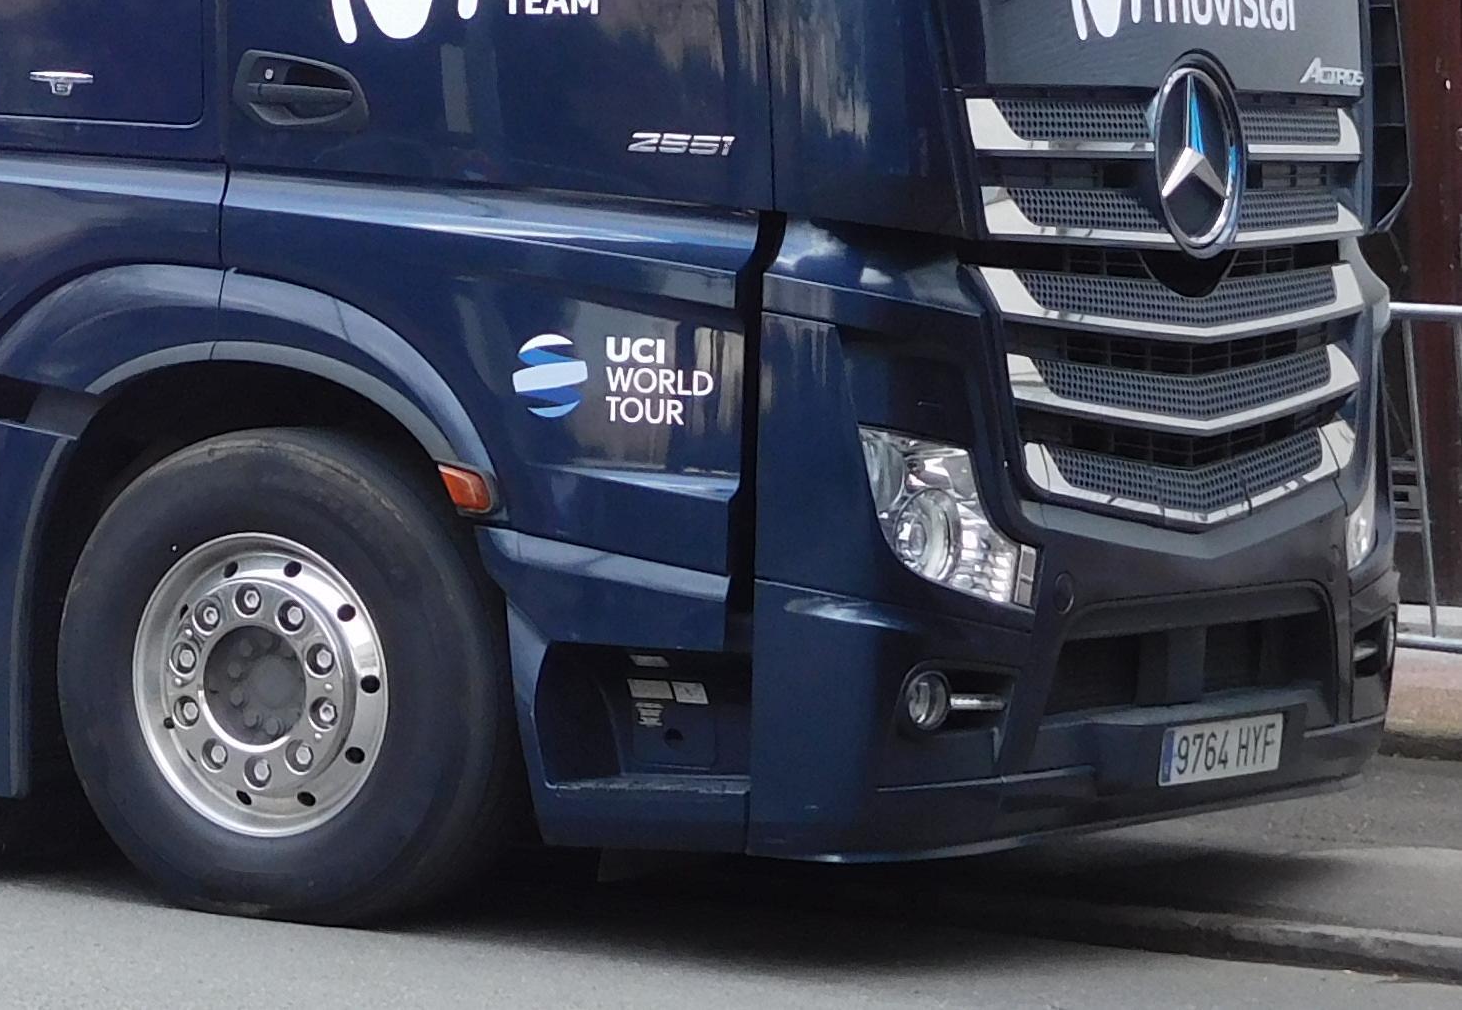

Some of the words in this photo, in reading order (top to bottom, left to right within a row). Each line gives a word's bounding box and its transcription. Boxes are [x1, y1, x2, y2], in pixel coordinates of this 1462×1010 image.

[627, 132, 735, 156] 2551
[605, 336, 665, 364] UCI
[605, 366, 714, 397] WORLD
[605, 395, 685, 425] TOUR
[1176, 730, 1229, 775] 9764
[1236, 723, 1276, 768] HYF
